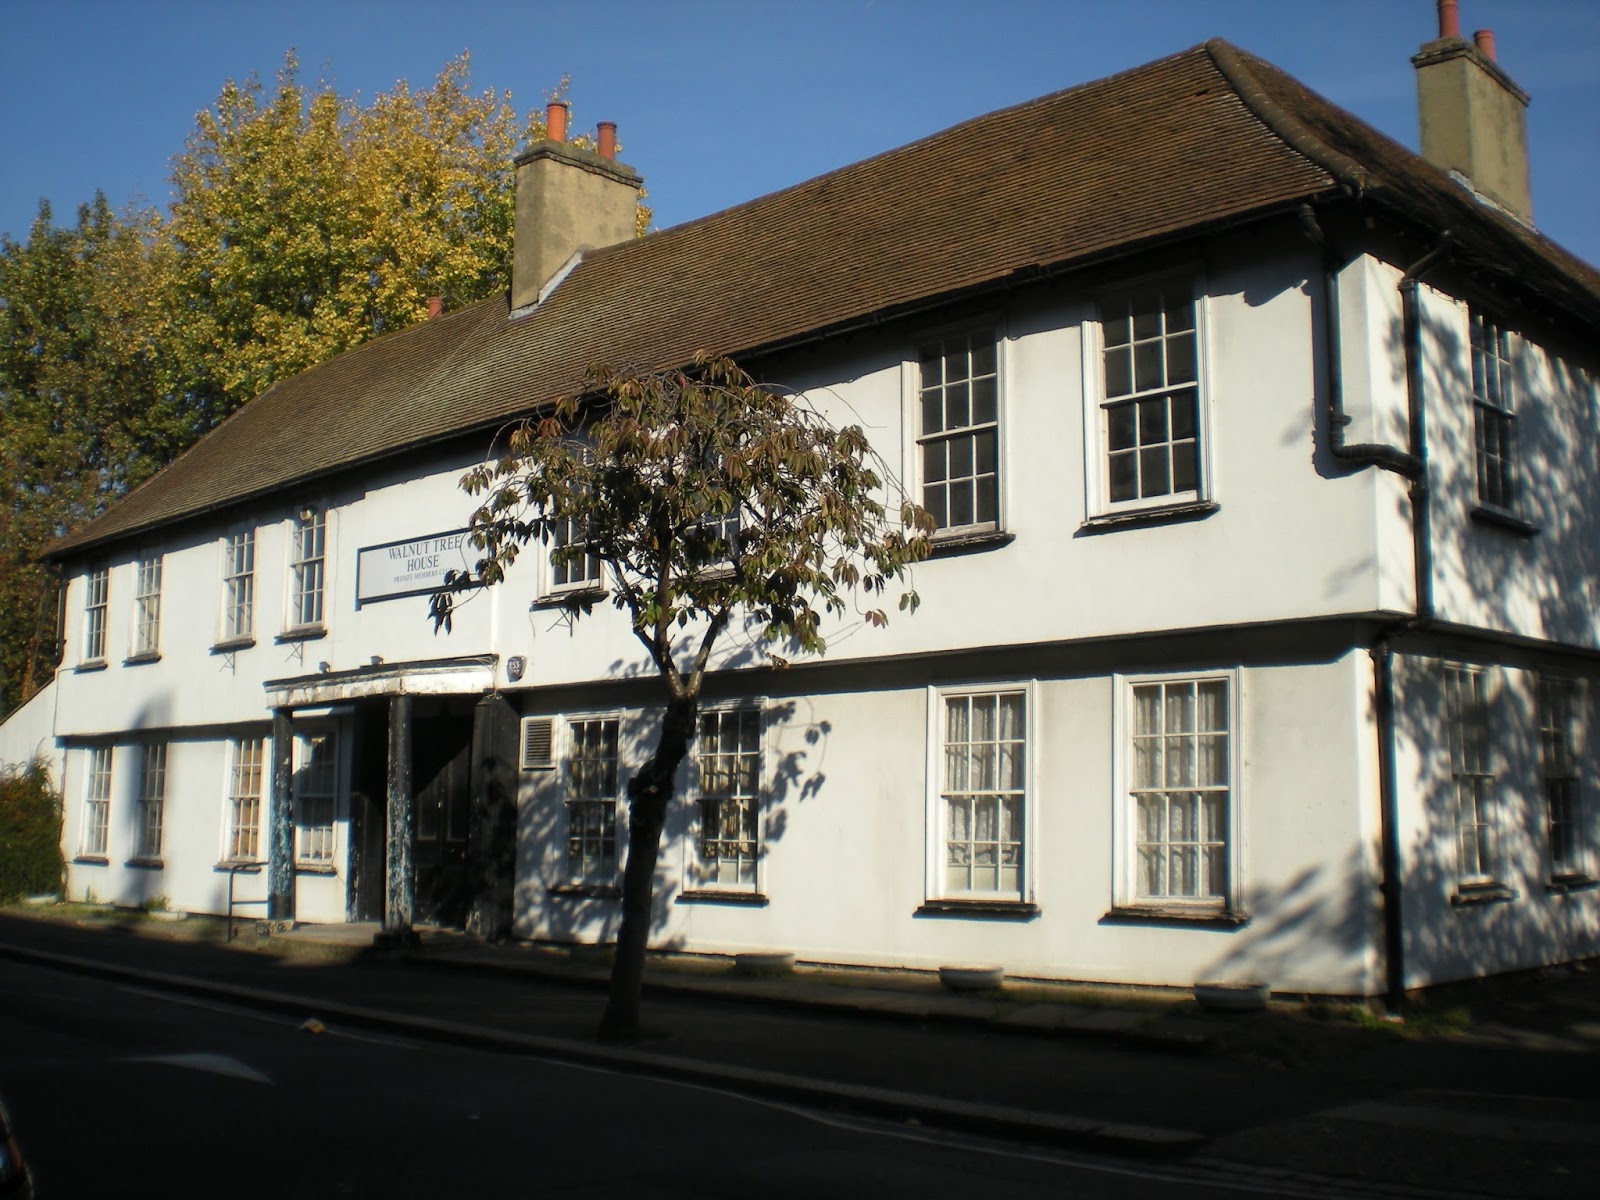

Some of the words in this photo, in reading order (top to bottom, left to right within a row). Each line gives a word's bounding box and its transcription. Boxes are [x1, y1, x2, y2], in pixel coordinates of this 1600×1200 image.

[388, 541, 430, 560] WALNUT
[434, 535, 461, 552] TREE
[407, 554, 440, 572] HOUSE
[393, 573, 413, 583] PRIVATE
[414, 569, 438, 581] MEMBERS
